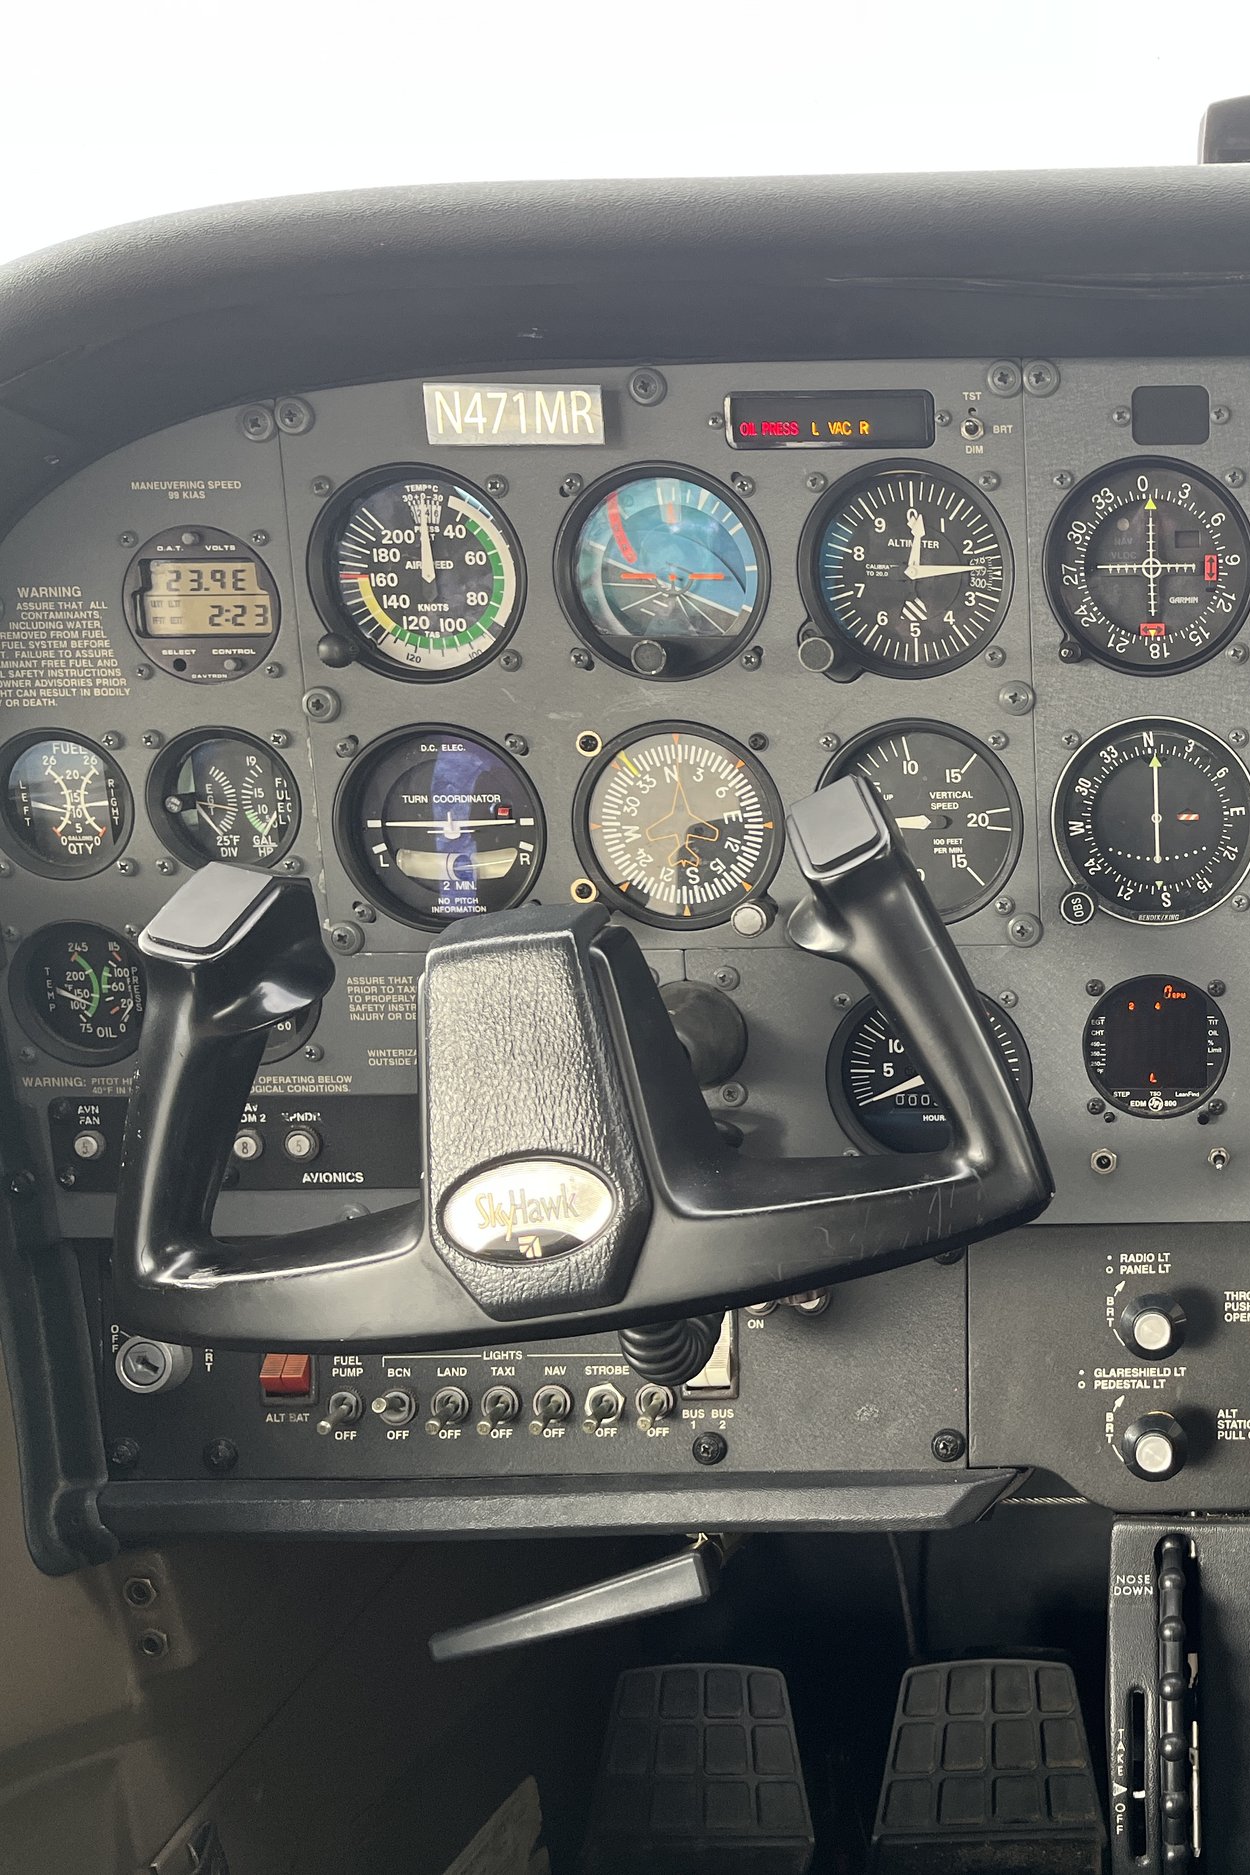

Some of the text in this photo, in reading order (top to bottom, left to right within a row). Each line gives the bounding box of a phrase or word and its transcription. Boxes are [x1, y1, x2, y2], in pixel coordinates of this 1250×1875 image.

[434, 390, 595, 434] N471MR
[740, 421, 869, 435] OIL PRESS L VAC R
[993, 425, 1013, 433] BRT
[131, 481, 241, 491] MANEUVERING SPEED
[182, 491, 206, 499] KIAS
[382, 530, 415, 544] 200
[444, 525, 466, 539] 40
[373, 549, 400, 562] 180
[465, 552, 486, 565] 60
[371, 573, 398, 587] 160
[18, 587, 81, 598] WARNING
[383, 595, 410, 609] 140
[466, 592, 488, 605] 80
[17, 601, 107, 610] ASSURE THAT ALL
[209, 604, 268, 626] 2:23
[10, 621, 63, 630] INCLUDING
[403, 616, 466, 632] 120 100
[0, 630, 107, 639] REMOVED FROM FUEL
[2, 640, 110, 649] FUEL SYSTEM BEFORE
[903, 761, 918, 774] 10
[946, 769, 961, 783] 15
[402, 795, 500, 803] TURN COORDINATOR
[930, 791, 973, 799] VERTICAL
[967, 813, 989, 827] 20
[952, 855, 967, 868] 15
[444, 881, 477, 890] 2 MIN.
[303, 1172, 364, 1184] AVIONICS
[1120, 1253, 1170, 1262] RADIO LT
[1120, 1265, 1171, 1275] PANEL LT
[334, 1356, 362, 1366] FUEL
[483, 1351, 522, 1361] LIGHTS
[332, 1368, 363, 1378] PUMP
[388, 1368, 411, 1378] BCN
[437, 1367, 467, 1377] LAND
[491, 1367, 515, 1377] TAXI
[544, 1366, 566, 1376] NAV
[585, 1365, 629, 1375] STROBE
[1116, 1574, 1150, 1584] NOSE
[1113, 1586, 1153, 1596] DOWN
